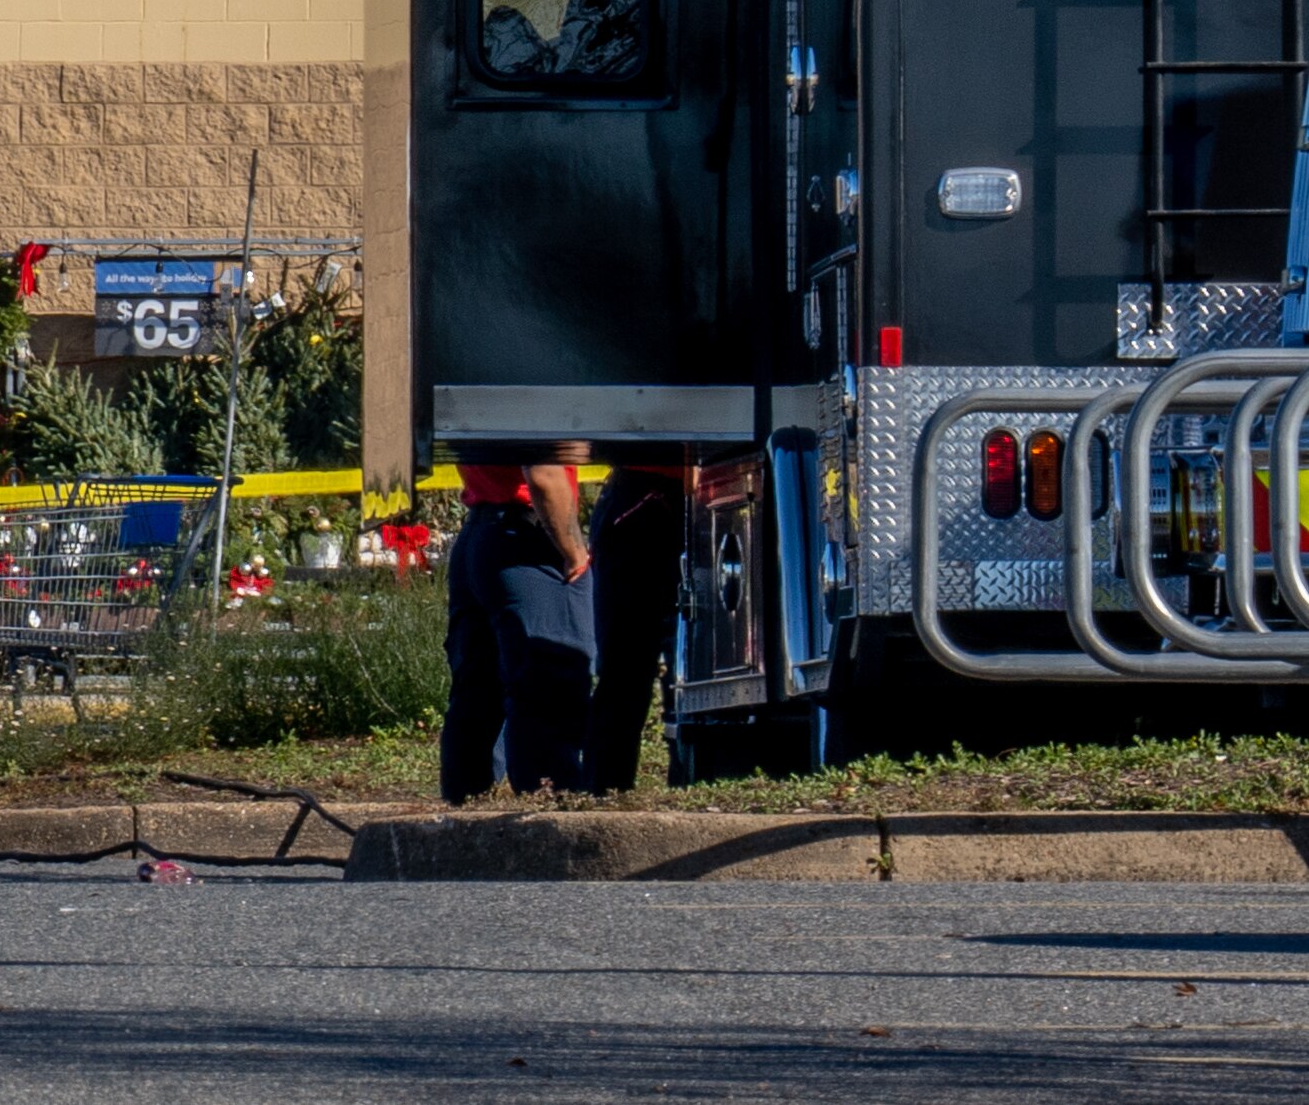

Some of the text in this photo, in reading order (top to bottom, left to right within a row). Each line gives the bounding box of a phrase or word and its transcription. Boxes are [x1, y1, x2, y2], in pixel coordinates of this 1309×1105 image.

[105, 274, 119, 283] All
[120, 274, 136, 283] the
[138, 276, 155, 286] way
